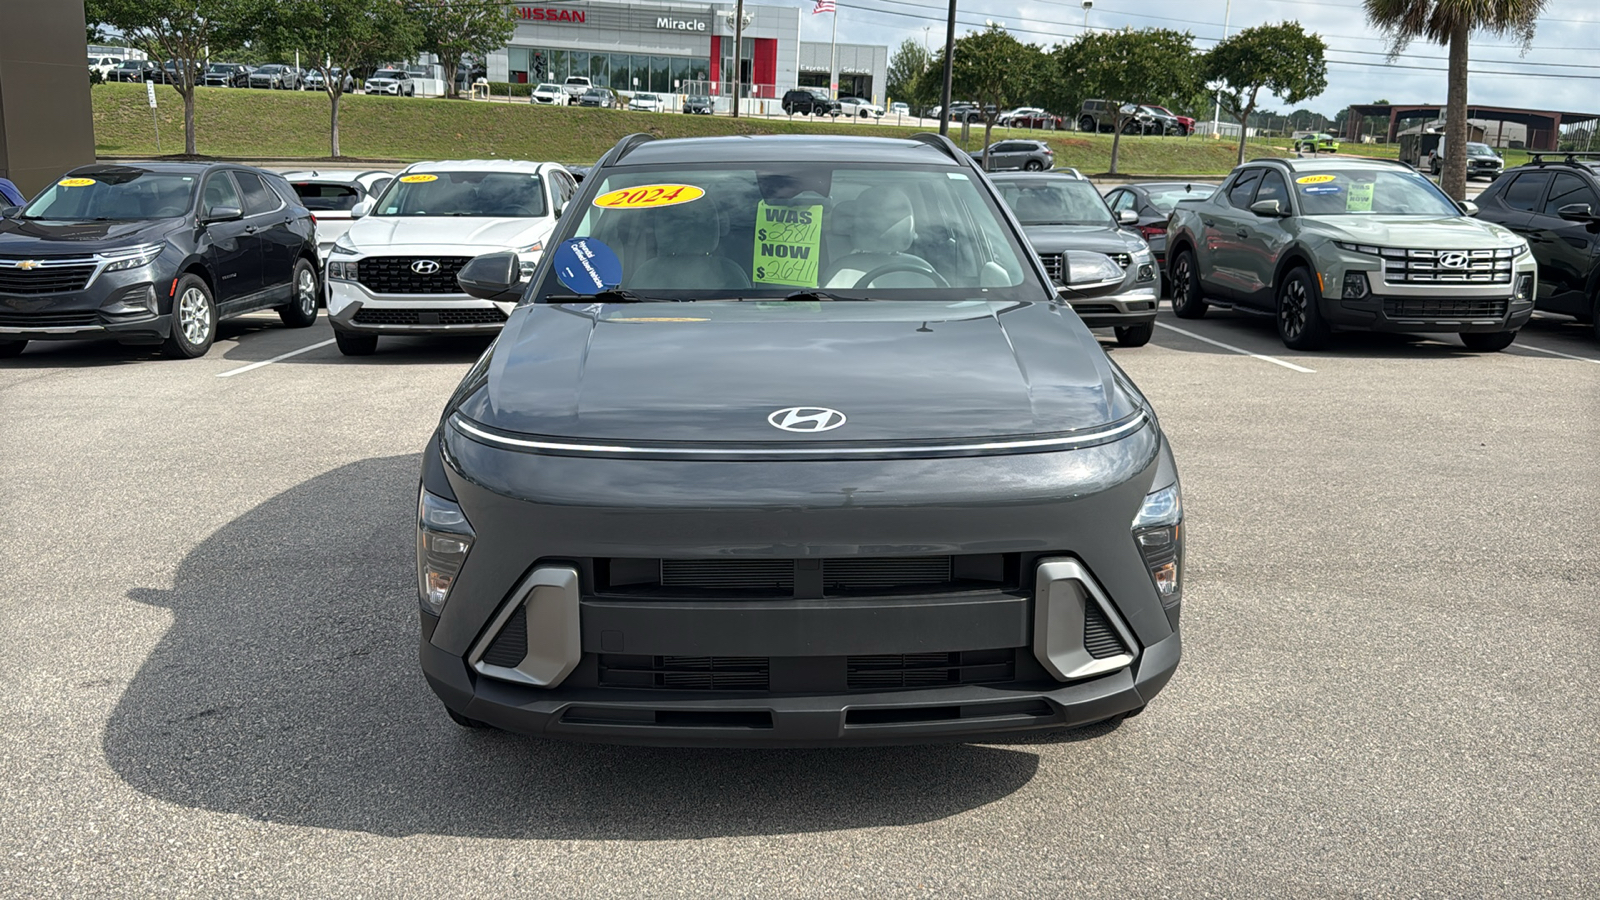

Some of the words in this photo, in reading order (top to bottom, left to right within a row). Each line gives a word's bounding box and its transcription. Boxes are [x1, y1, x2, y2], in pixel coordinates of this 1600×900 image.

[656, 17, 706, 31] Miracle
[843, 66, 870, 74] Service
[607, 186, 685, 206] 2024
[765, 208, 813, 225] WAS
[577, 240, 596, 259] Hyundai
[761, 243, 811, 260] NOW
[570, 243, 588, 262] Certified
[581, 259, 595, 272] Used
[588, 270, 604, 289] Vehicles
